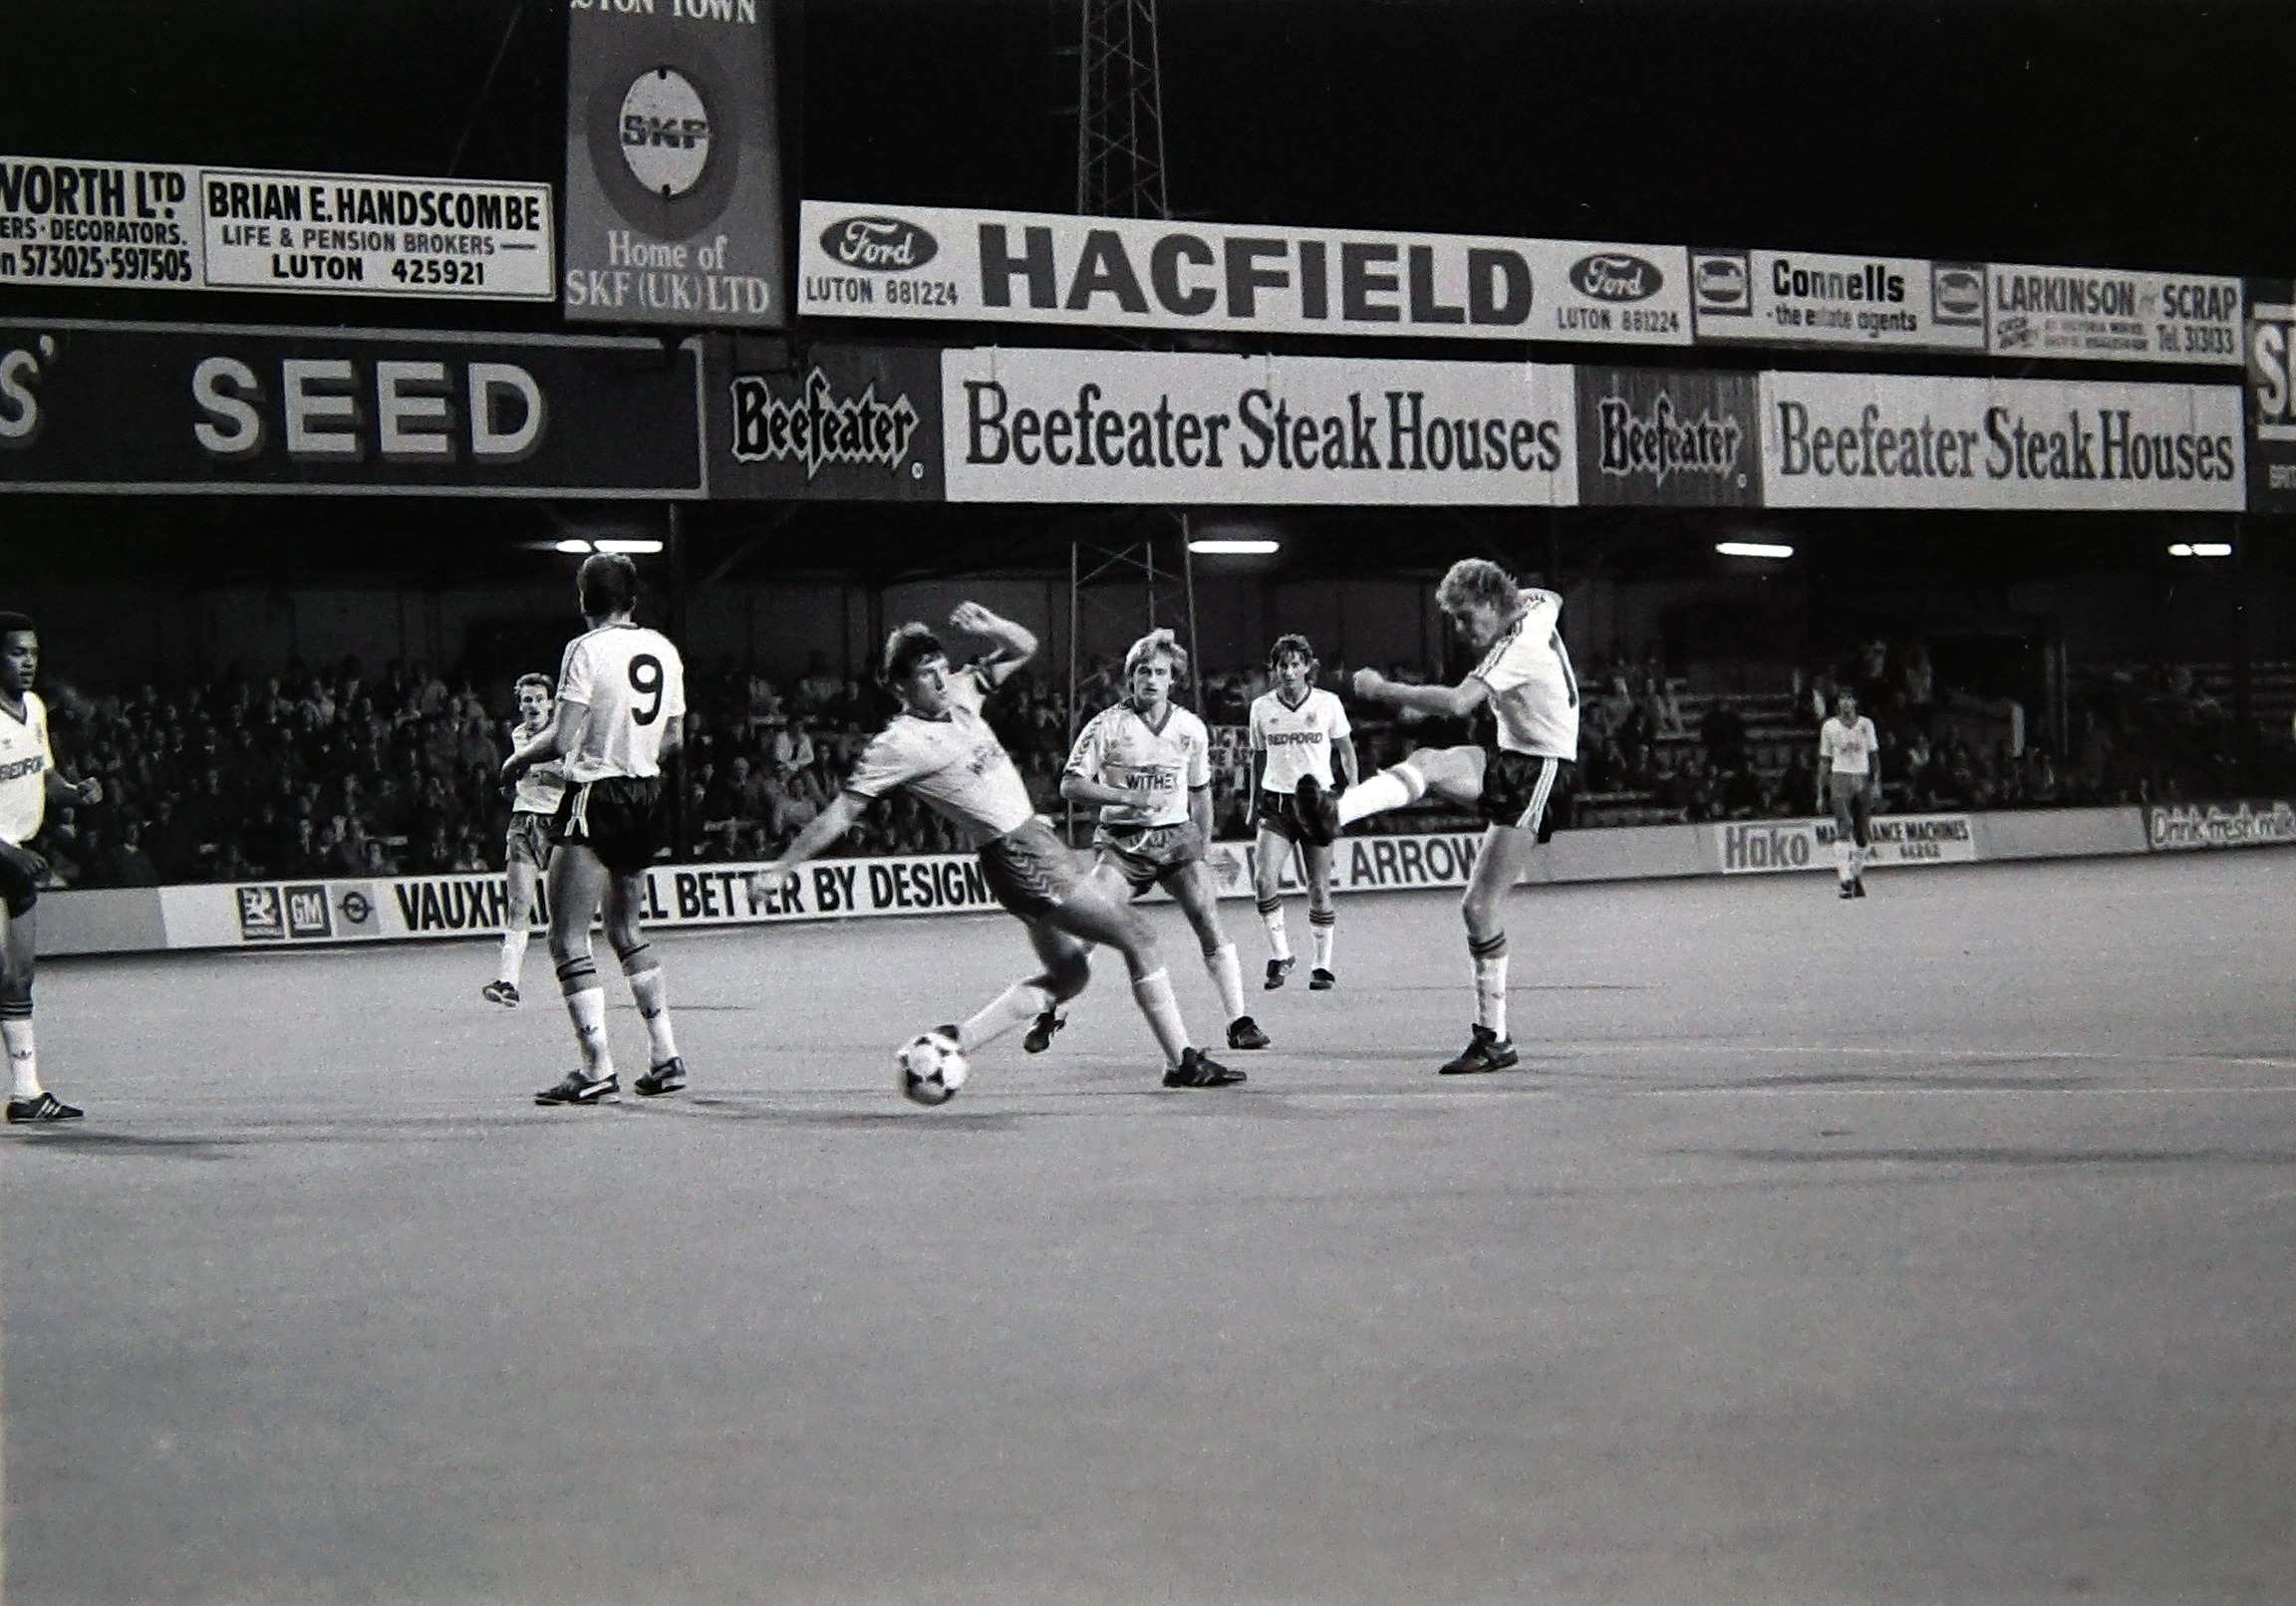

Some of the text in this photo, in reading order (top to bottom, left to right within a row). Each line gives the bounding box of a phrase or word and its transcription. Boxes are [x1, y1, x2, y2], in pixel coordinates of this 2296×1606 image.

[623, 115, 708, 148] SKF
[0, 216, 37, 239] ERS
[207, 181, 302, 221] BRIAN
[337, 187, 541, 230] HANDSCOMBE
[221, 224, 496, 256] LIFE & PENSION BROKERS
[609, 230, 728, 270] Home of
[839, 221, 915, 265] Ford
[271, 254, 485, 286] LUTON 425921
[566, 269, 631, 307] SKF
[708, 275, 769, 314] LTD
[806, 276, 958, 306] LUTON 881224
[978, 223, 1534, 327] HACFIELD
[1773, 259, 1904, 302] Connells
[1558, 307, 1611, 330] LUTON
[1997, 275, 2136, 316] LARKINSON
[2161, 283, 2237, 321] SCRAP
[1806, 306, 1852, 331] eate
[1859, 309, 1918, 339] agents
[192, 356, 543, 454] SEED
[731, 369, 919, 478] Beefeater
[963, 381, 1562, 472] Beefeater Steak Houses
[1597, 393, 1741, 484] Beefeater
[1777, 399, 2235, 481] Beefeater Steak Houses
[628, 654, 664, 725] 9
[1267, 732, 1322, 746] BEDFORD
[813, 865, 857, 913] BY
